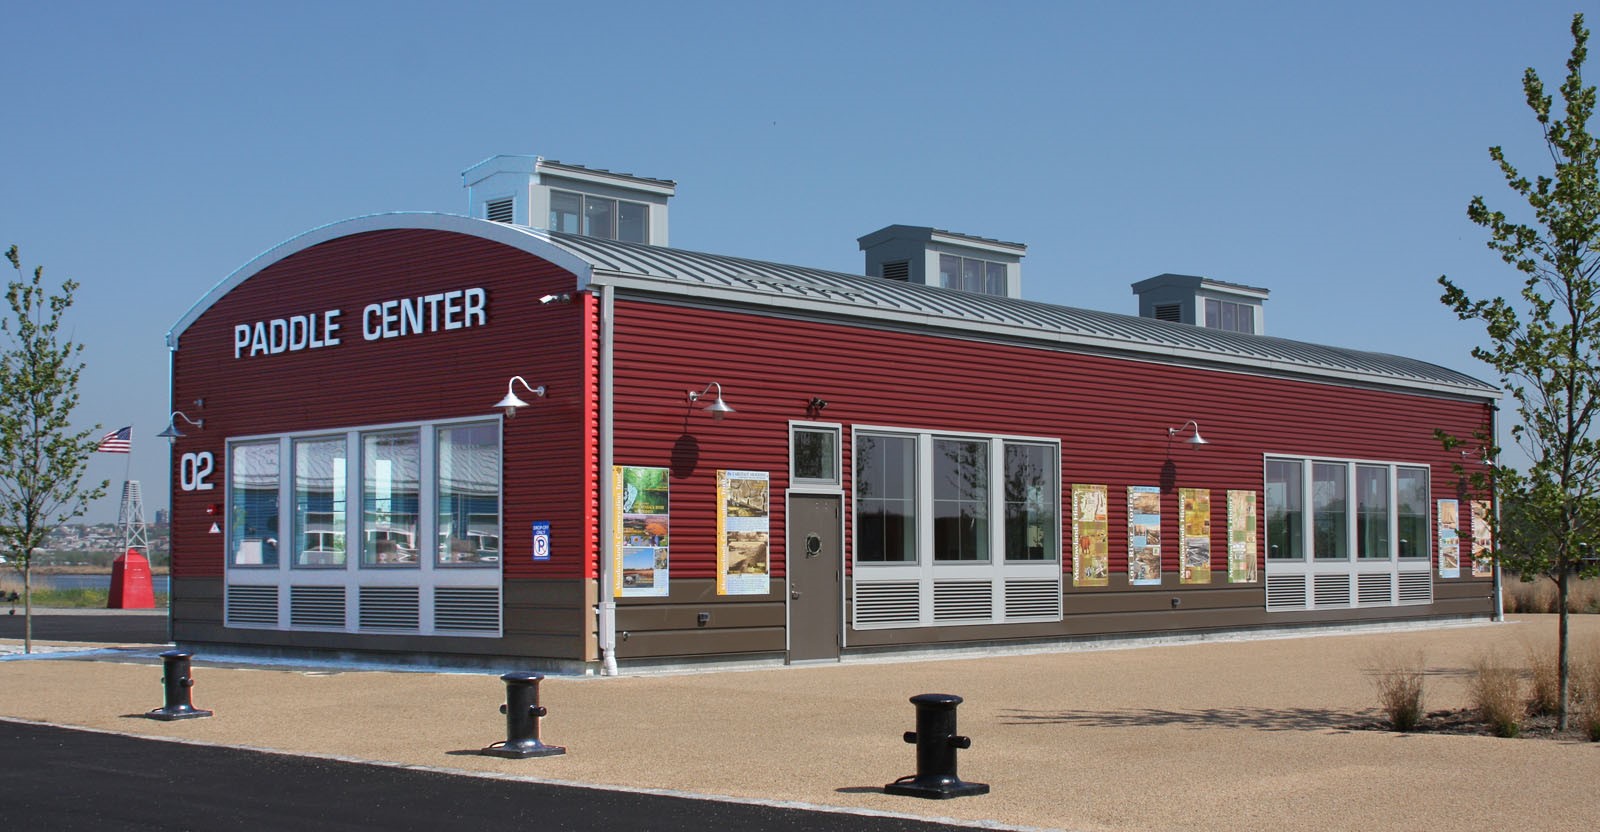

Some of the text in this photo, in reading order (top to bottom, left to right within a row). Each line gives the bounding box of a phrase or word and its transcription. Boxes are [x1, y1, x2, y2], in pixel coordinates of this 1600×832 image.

[234, 287, 486, 359] PADDLE CENTER
[180, 451, 215, 491] 02
